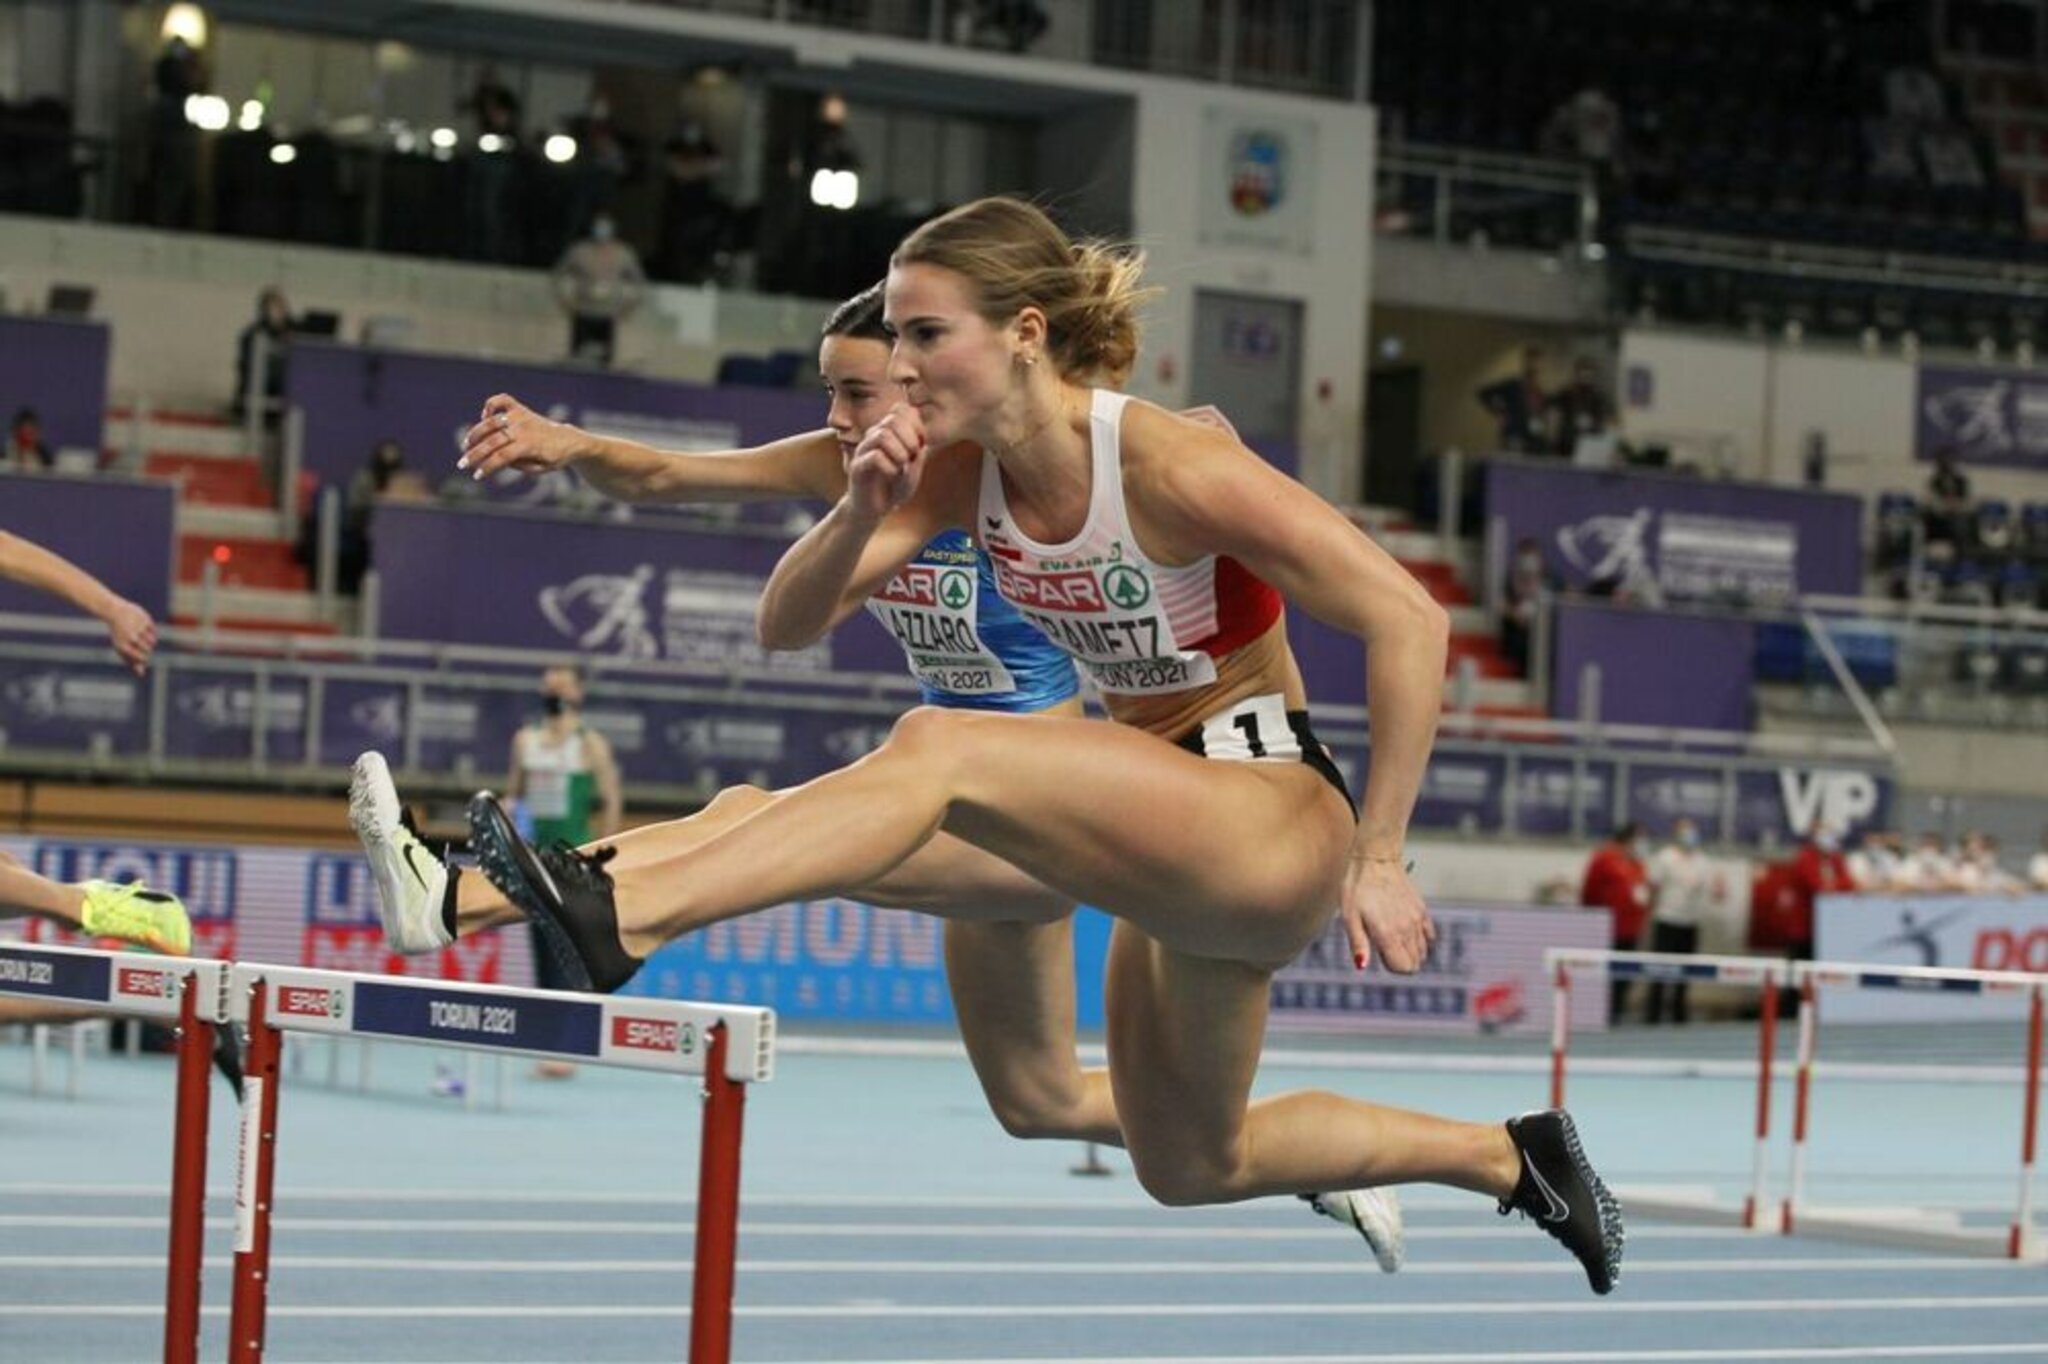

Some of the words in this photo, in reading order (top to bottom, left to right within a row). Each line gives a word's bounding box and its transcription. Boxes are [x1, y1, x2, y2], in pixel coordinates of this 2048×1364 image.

[885, 573, 934, 602] AR
[950, 670, 992, 689] 2021
[1135, 663, 1189, 688] 2021
[1233, 711, 1267, 758] 1
[289, 991, 329, 1013] SPAR
[482, 1006, 516, 1034] 2021
[626, 1022, 676, 1048] SPAR
